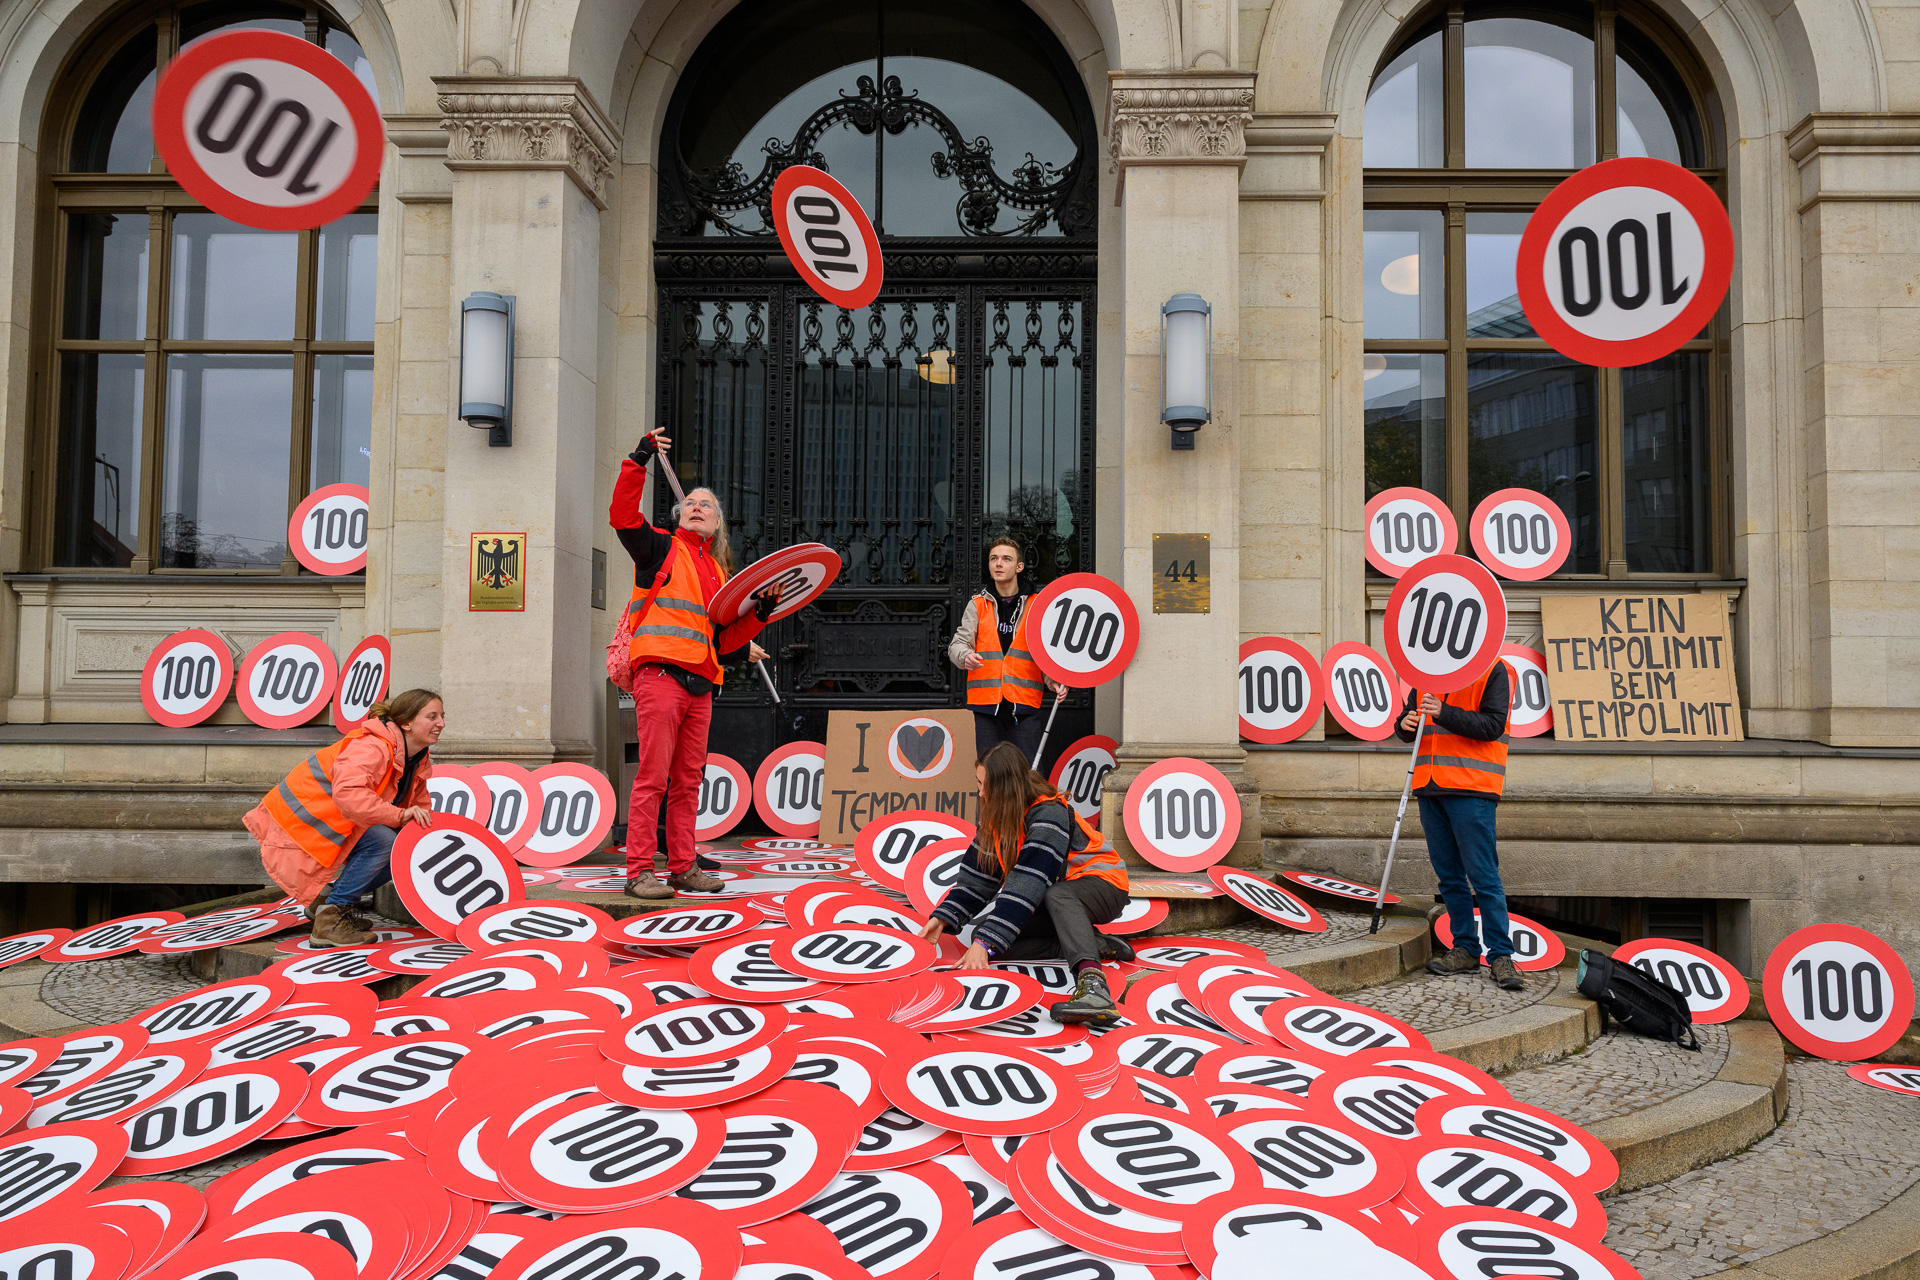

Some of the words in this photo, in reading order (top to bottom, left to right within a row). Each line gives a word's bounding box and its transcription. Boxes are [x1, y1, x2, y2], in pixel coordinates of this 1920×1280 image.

[195, 71, 344, 197] 100
[793, 196, 858, 280] 100
[1559, 212, 1688, 317] 100
[311, 509, 369, 549] 100
[1377, 512, 1437, 553] 100
[1490, 513, 1550, 554] 100
[1165, 560, 1197, 582] 44
[1050, 598, 1119, 661] 100
[1408, 588, 1481, 659] 100
[1600, 598, 1685, 635] KEIN
[1547, 635, 1722, 674] TEMPOLIMIT
[162, 656, 215, 700] 100
[258, 655, 319, 704] 100
[344, 661, 383, 708] 100
[1239, 666, 1302, 713] 100
[1335, 668, 1388, 712] 100
[1611, 671, 1676, 701] BEIM
[1557, 700, 1732, 739] TEMPOLIMIT
[852, 722, 871, 773] I
[540, 791, 593, 836] 00
[1147, 789, 1217, 839] 100
[766, 840, 832, 850] 100
[775, 862, 841, 873] 100
[419, 834, 504, 919] 100
[1227, 878, 1307, 918] 100
[1309, 876, 1378, 898] 100
[637, 913, 734, 934] 100
[799, 934, 901, 969] 100
[149, 991, 257, 1036] 100
[1792, 960, 1883, 1022] 100
[219, 1019, 337, 1061] 10
[635, 1008, 755, 1052] 100
[329, 1046, 471, 1103] 100
[1131, 1038, 1204, 1078] 10
[1229, 1060, 1313, 1099] 10
[46, 1057, 168, 1125] 100
[917, 1063, 1047, 1107] 100
[129, 1080, 264, 1152] 100
[1468, 1109, 1569, 1162] 00
[549, 1106, 683, 1182] 100
[1090, 1120, 1221, 1198] 100
[1250, 1126, 1365, 1189] 100
[1457, 1229, 1579, 1280] 00
